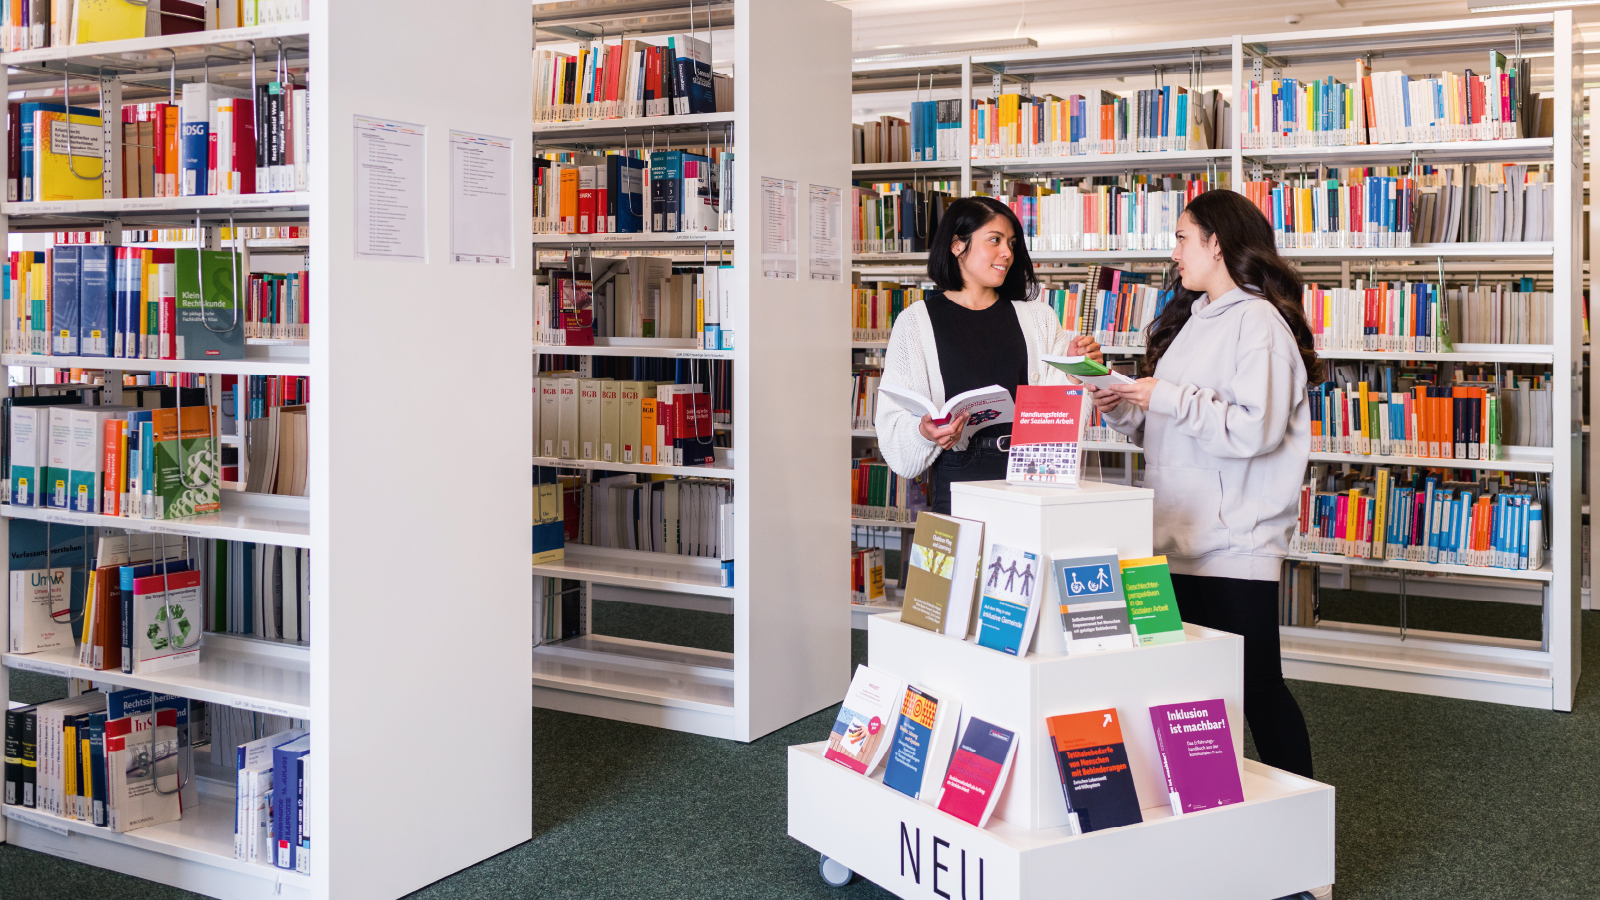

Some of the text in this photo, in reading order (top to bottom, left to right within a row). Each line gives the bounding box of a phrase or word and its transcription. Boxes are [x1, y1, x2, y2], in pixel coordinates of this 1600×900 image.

[182, 125, 204, 135] BDSG
[933, 534, 945, 543] Outdoor
[12, 545, 82, 559] Verfassung verstehen
[938, 544, 951, 553] Learning
[1126, 582, 1159, 591] Geschlechter-
[1128, 590, 1160, 600] perspektiven
[1131, 604, 1169, 615] Sozialen Arbeit
[1002, 616, 1022, 628] Gemeinde
[1167, 708, 1208, 721] Inklusion
[1169, 719, 1225, 734] ist machbar!
[1066, 746, 1114, 759] Teilhabebedarfe
[957, 754, 966, 763] Das
[968, 758, 983, 770] Recht
[1080, 756, 1109, 766] Menschen
[1071, 763, 1127, 777] mit Behinderungen
[900, 821, 984, 900] NEU
